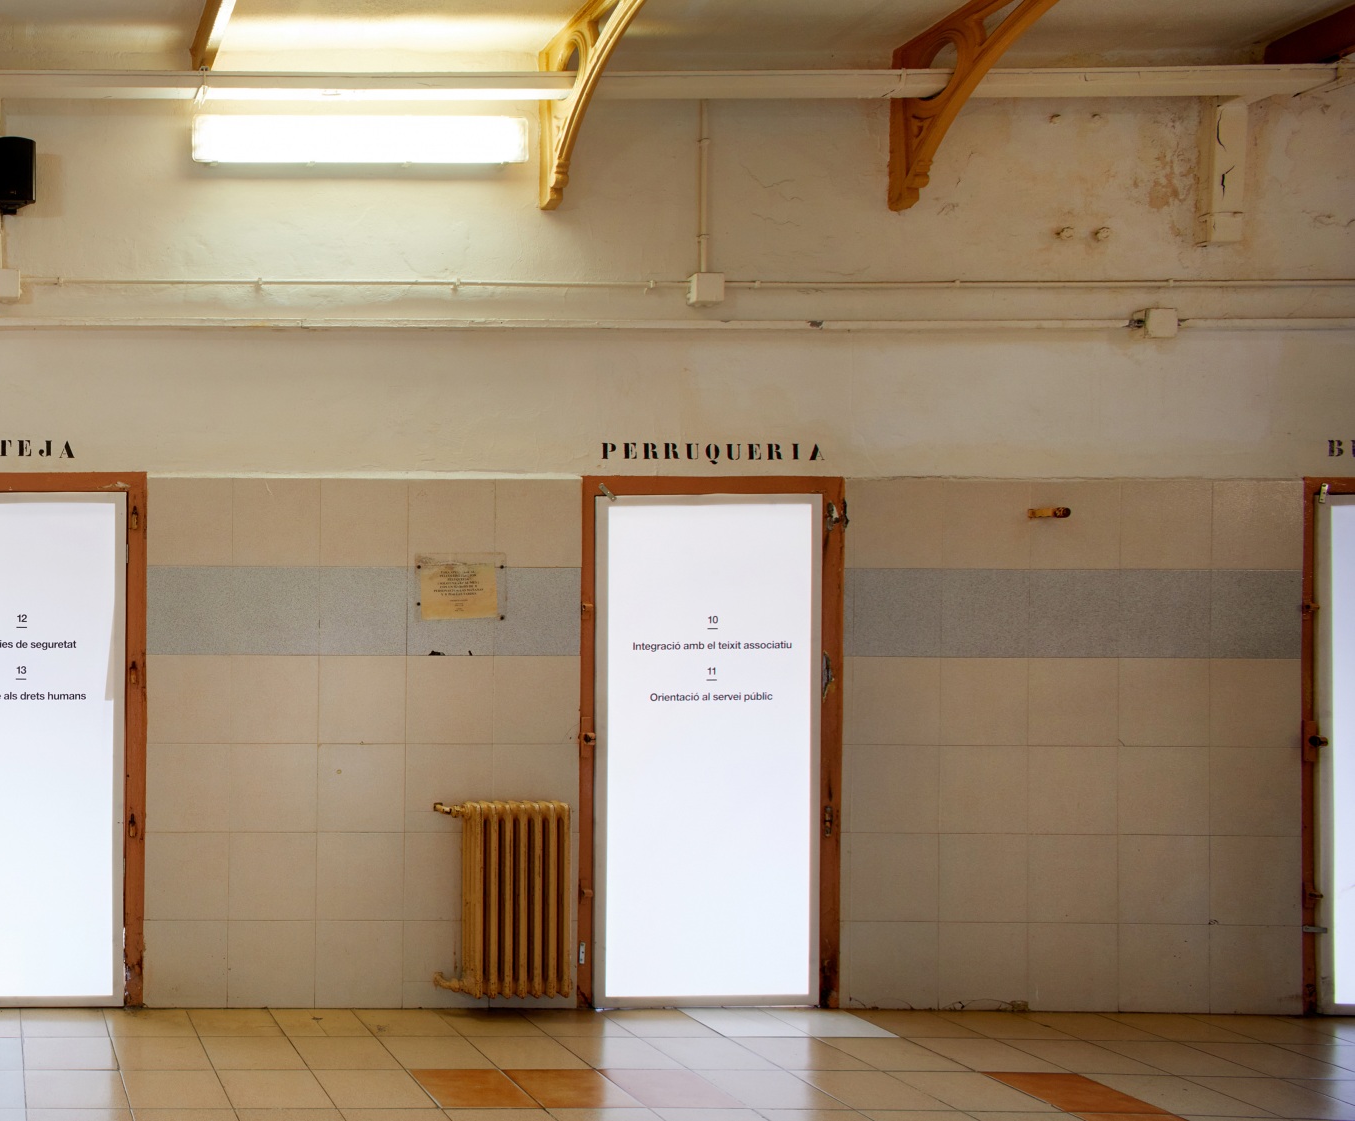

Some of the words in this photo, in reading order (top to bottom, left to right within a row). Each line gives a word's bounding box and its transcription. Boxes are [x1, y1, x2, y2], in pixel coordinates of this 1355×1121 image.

[601, 442, 826, 466] PERRUQUERIA
[16, 613, 28, 623] 12
[707, 615, 719, 625] 10
[15, 639, 29, 649] de
[30, 639, 77, 651] seguretat
[632, 641, 682, 653] Integració
[682, 641, 705, 651] amb
[706, 640, 716, 650] el
[717, 640, 742, 650] teixit
[743, 640, 793, 650] associatiu
[16, 665, 27, 675] 13
[707, 666, 717, 676] 11
[3, 691, 18, 701] als
[19, 691, 46, 701] drets
[47, 691, 87, 701] humans
[649, 692, 700, 702] Orientació
[701, 692, 711, 702] al
[712, 691, 742, 702] servei
[743, 691, 774, 703] públic
